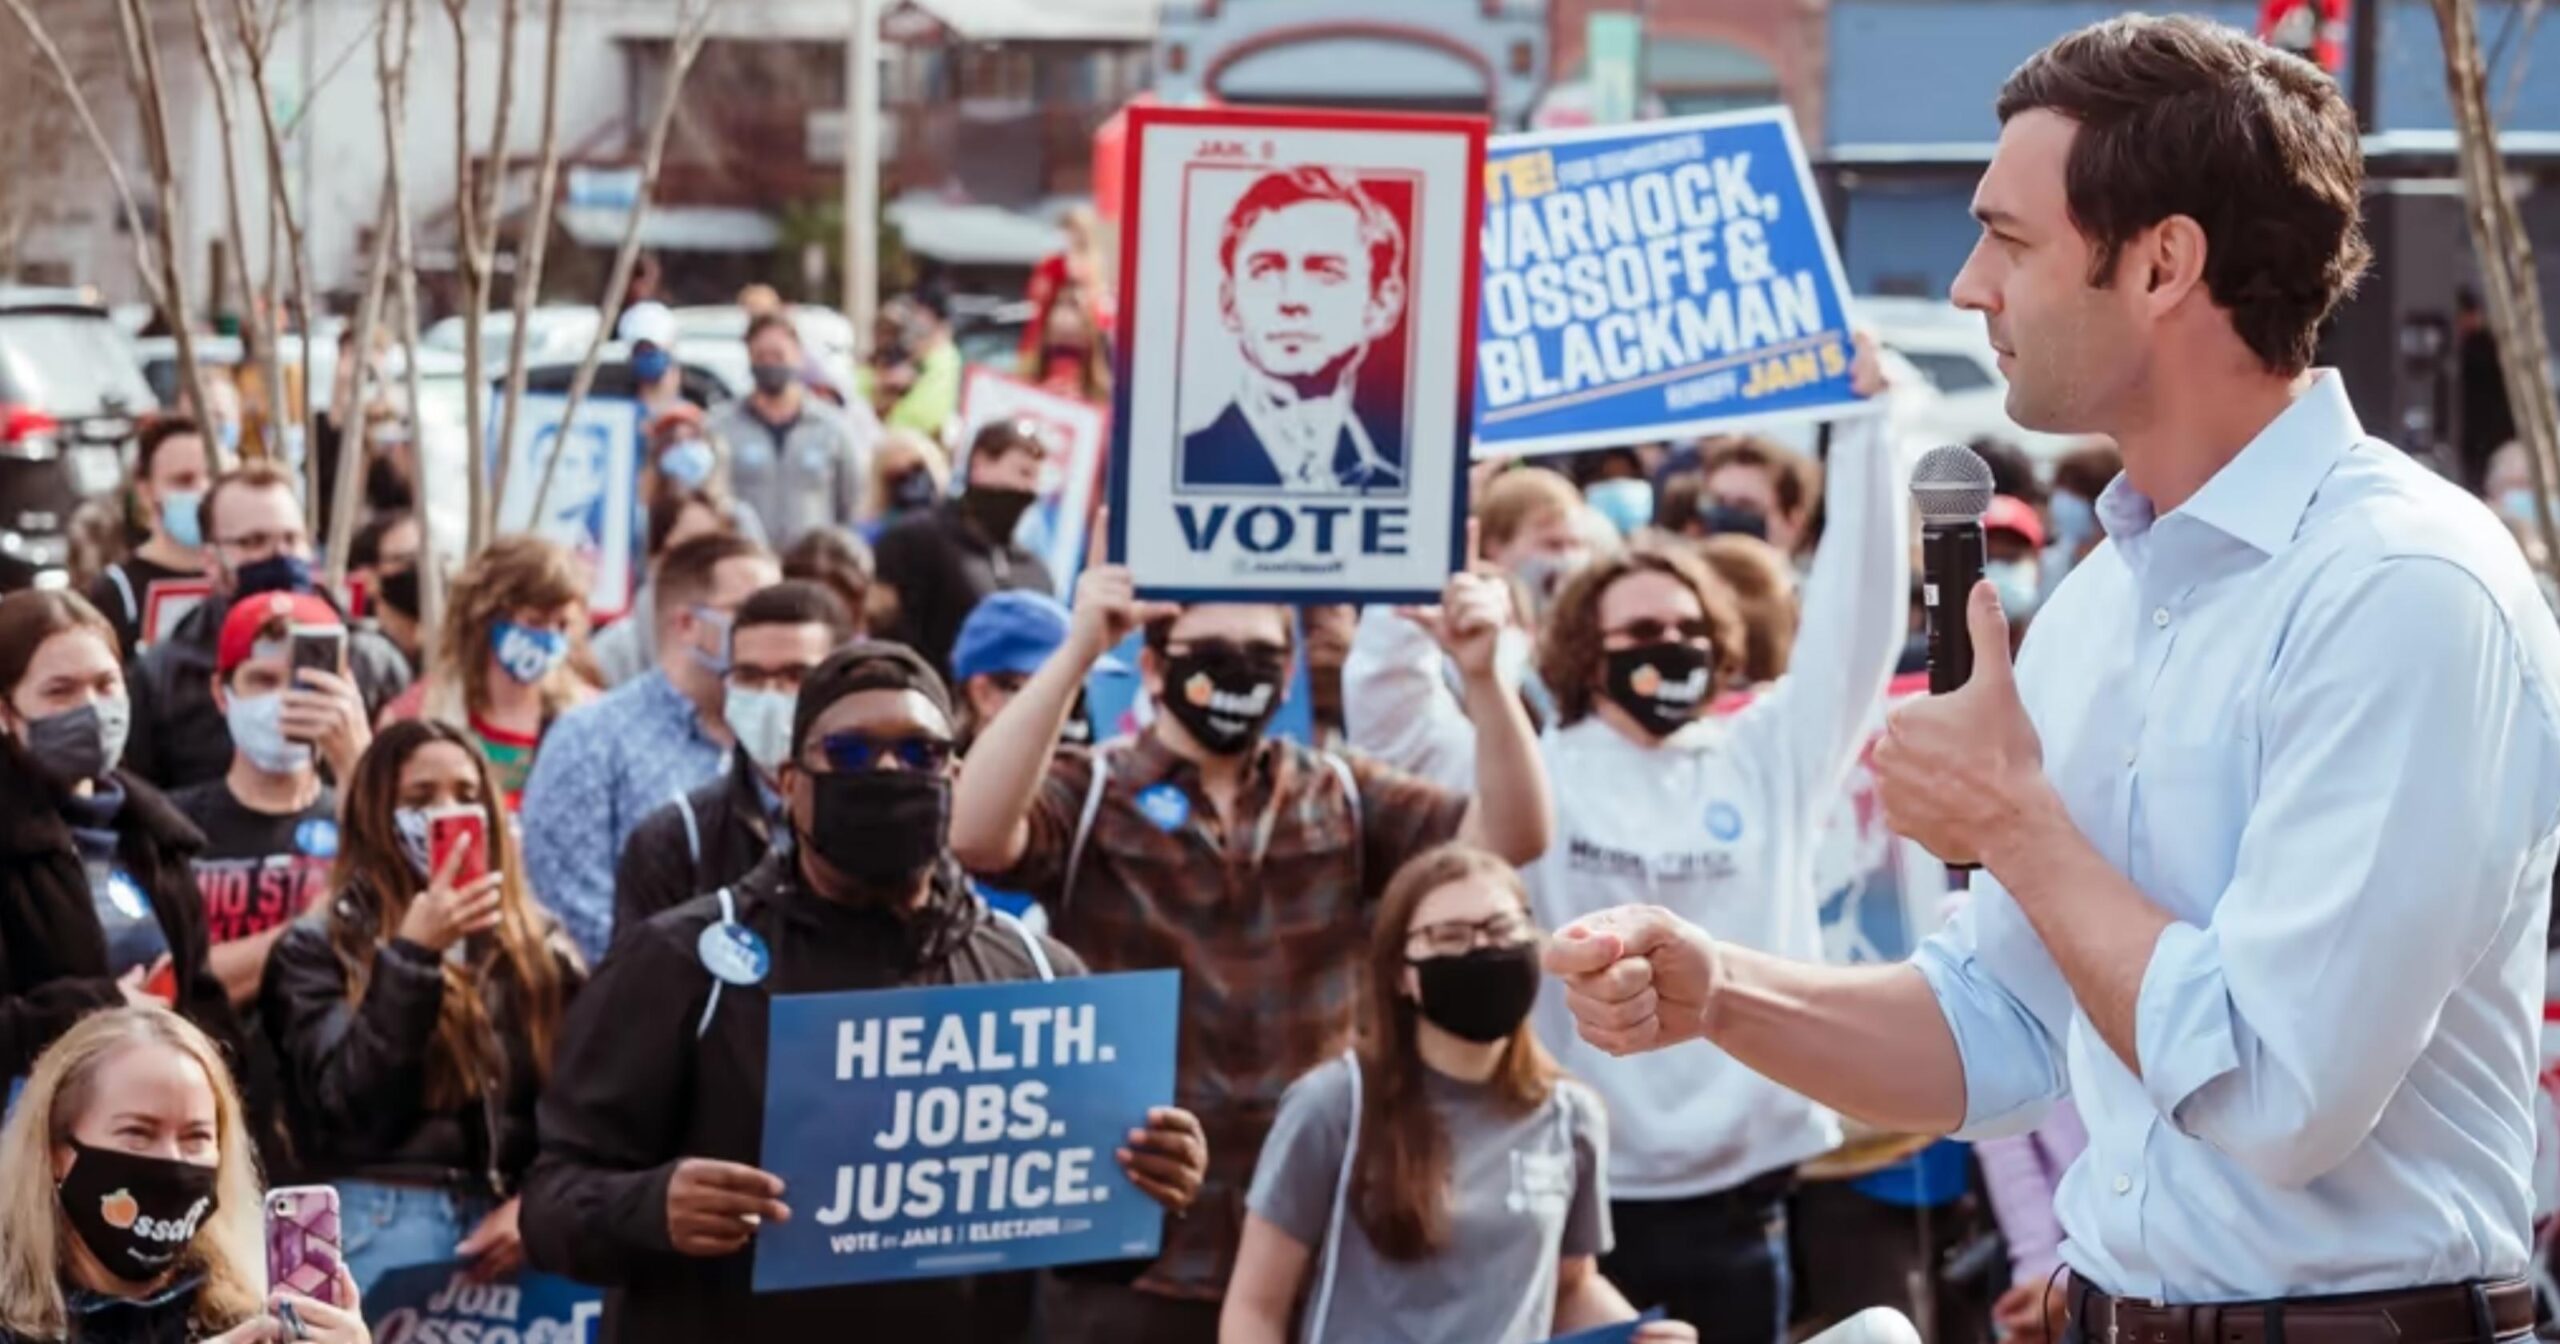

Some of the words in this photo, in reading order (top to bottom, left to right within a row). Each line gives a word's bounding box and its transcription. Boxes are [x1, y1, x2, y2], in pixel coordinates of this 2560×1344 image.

[1484, 227, 1718, 338] OSSOFF
[1723, 217, 1778, 284] &
[1478, 269, 1823, 408] BLACKMAN
[1741, 349, 1820, 399] JAN
[1820, 341, 1847, 377] 5
[1172, 503, 1411, 556] VOTE
[835, 1004, 1116, 1080] HEALTH.
[874, 1080, 1066, 1150] JOBS.
[815, 1147, 1110, 1226] JUSTICE.
[830, 1232, 880, 1254] VOTE
[901, 1226, 940, 1248] JAN
[427, 1271, 522, 1320] Jon
